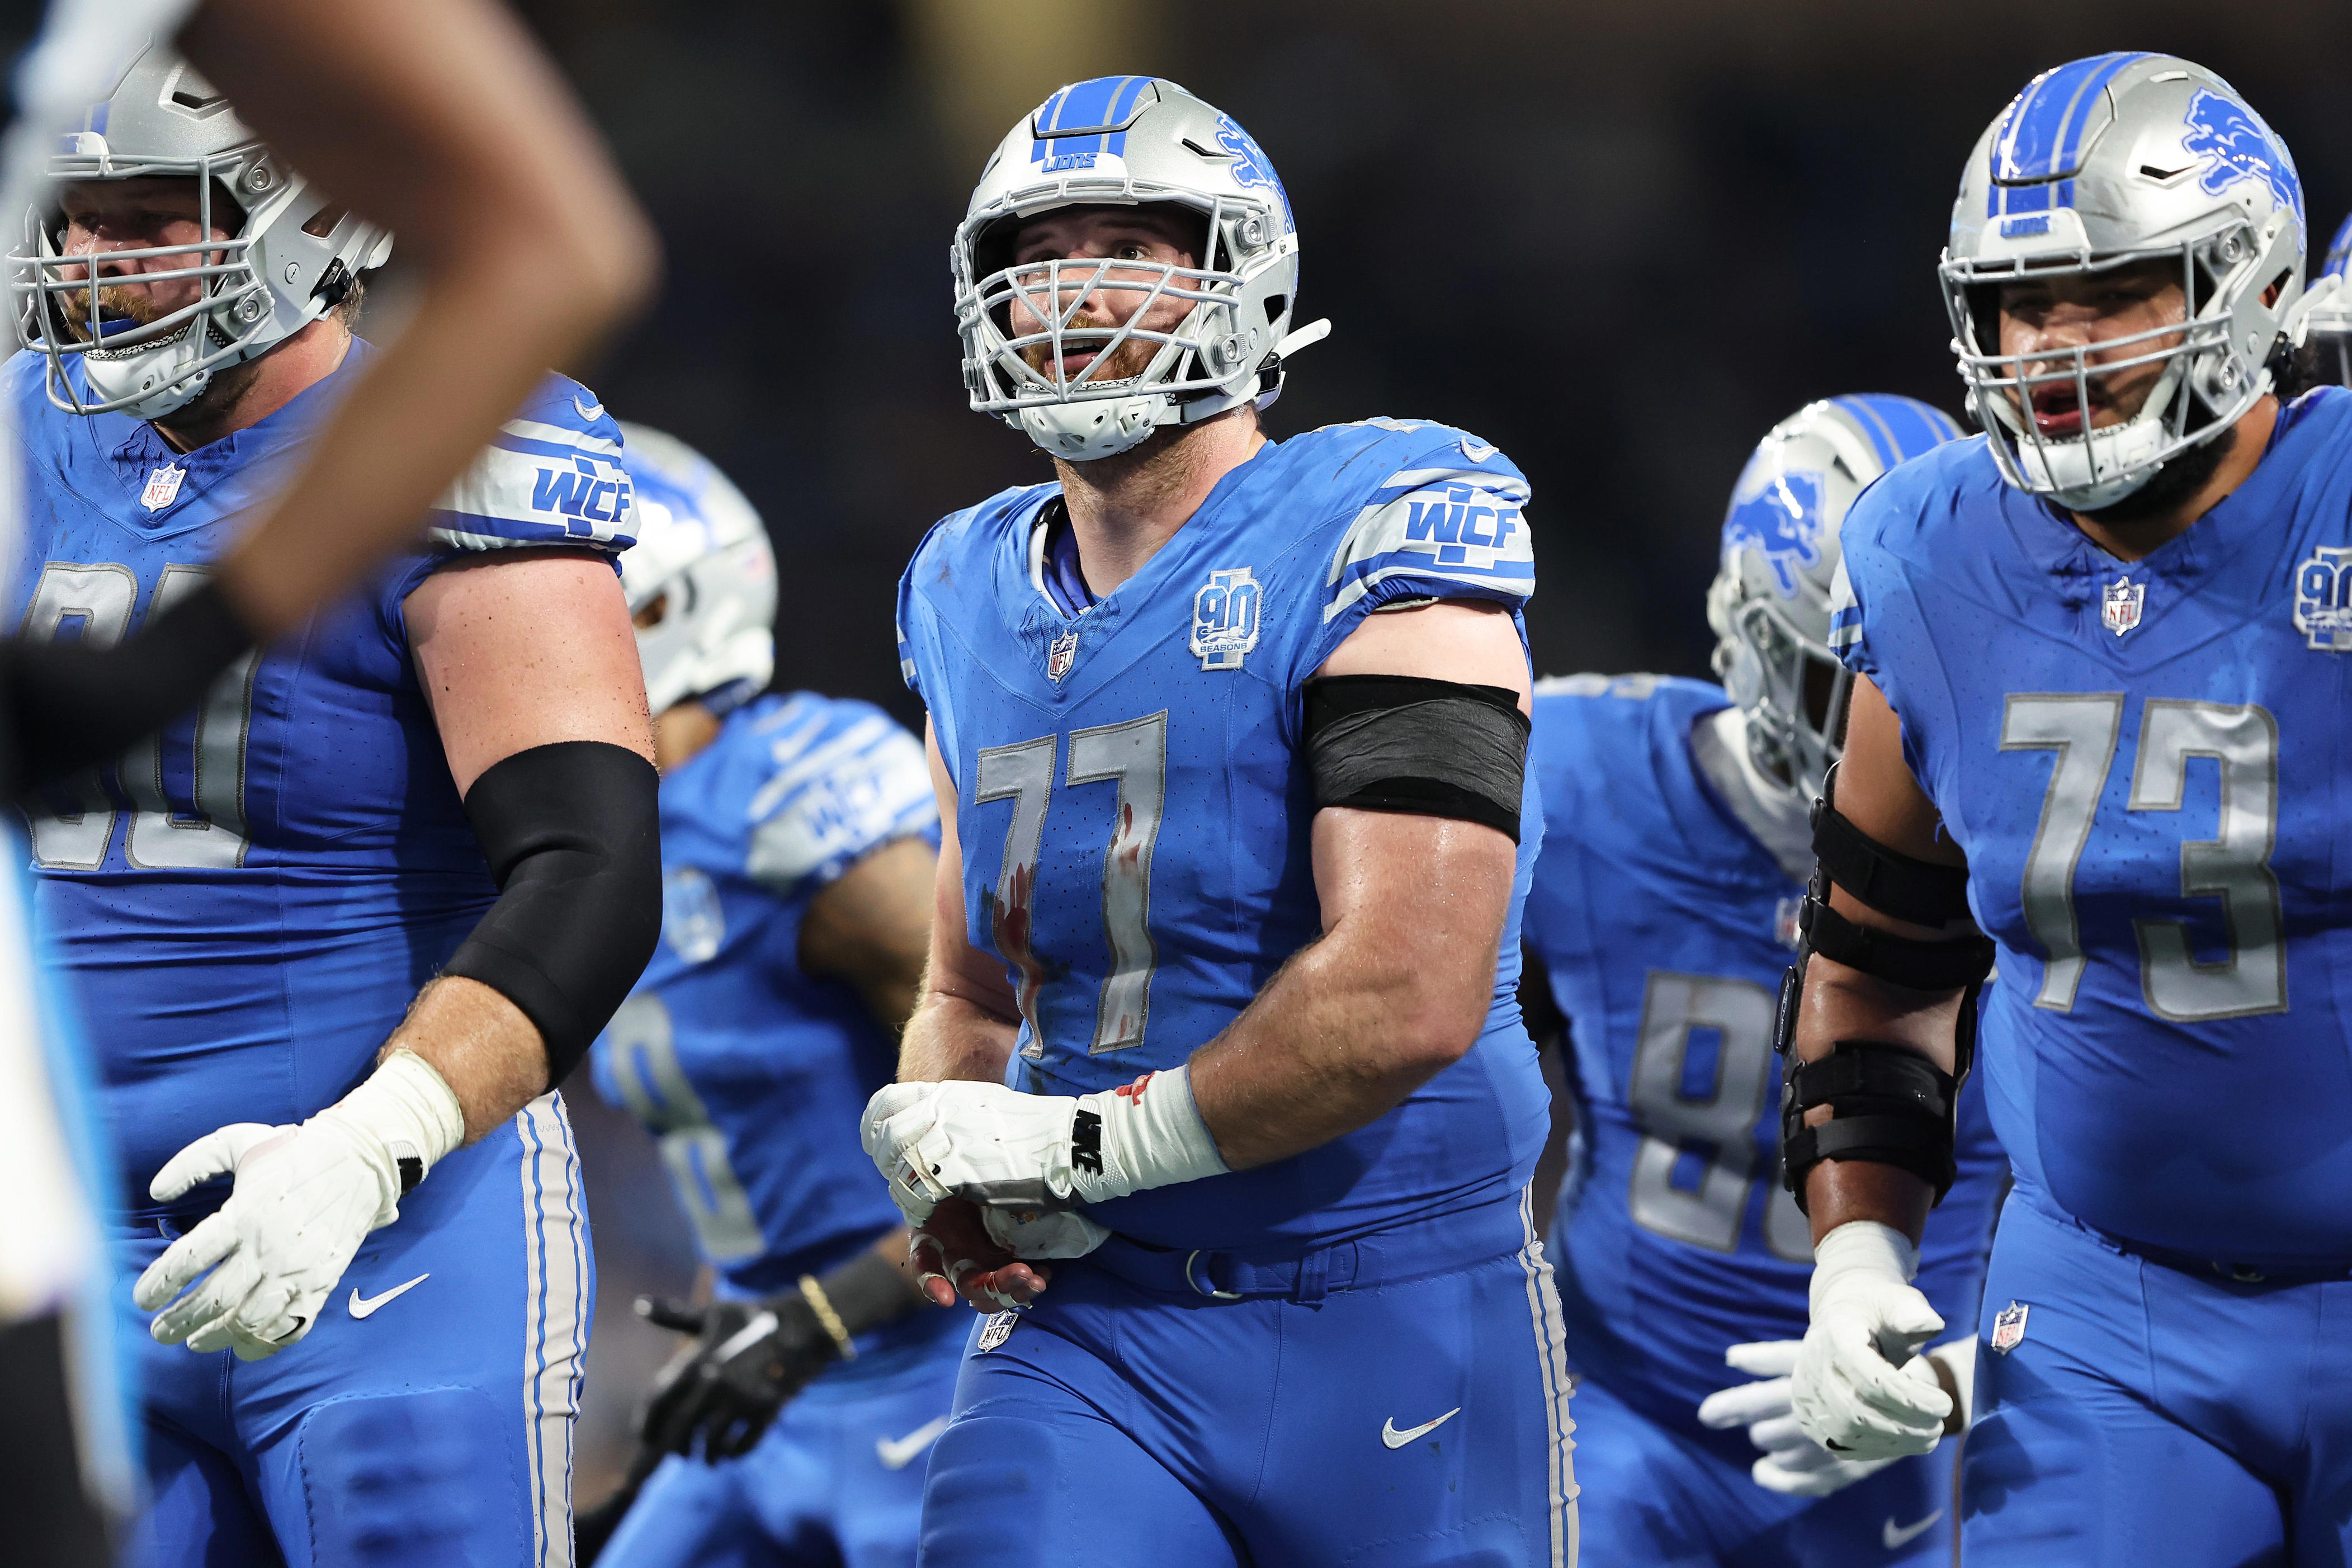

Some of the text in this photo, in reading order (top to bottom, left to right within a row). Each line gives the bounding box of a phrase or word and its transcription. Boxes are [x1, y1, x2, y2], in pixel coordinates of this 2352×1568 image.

[1042, 153, 1098, 173] LIONS
[147, 485, 171, 502] NFL
[532, 467, 631, 523] WCF
[1405, 502, 1519, 549] WCF
[1198, 584, 1258, 639] 90
[2109, 604, 2134, 624] NFL
[1051, 653, 1068, 673] NFL
[1200, 643, 1247, 653] SEASONS
[2000, 692, 2289, 1022] 73
[974, 708, 1168, 1059] 77
[1071, 1109, 1104, 1176] NIKE
[983, 1326, 1005, 1343] NFL
